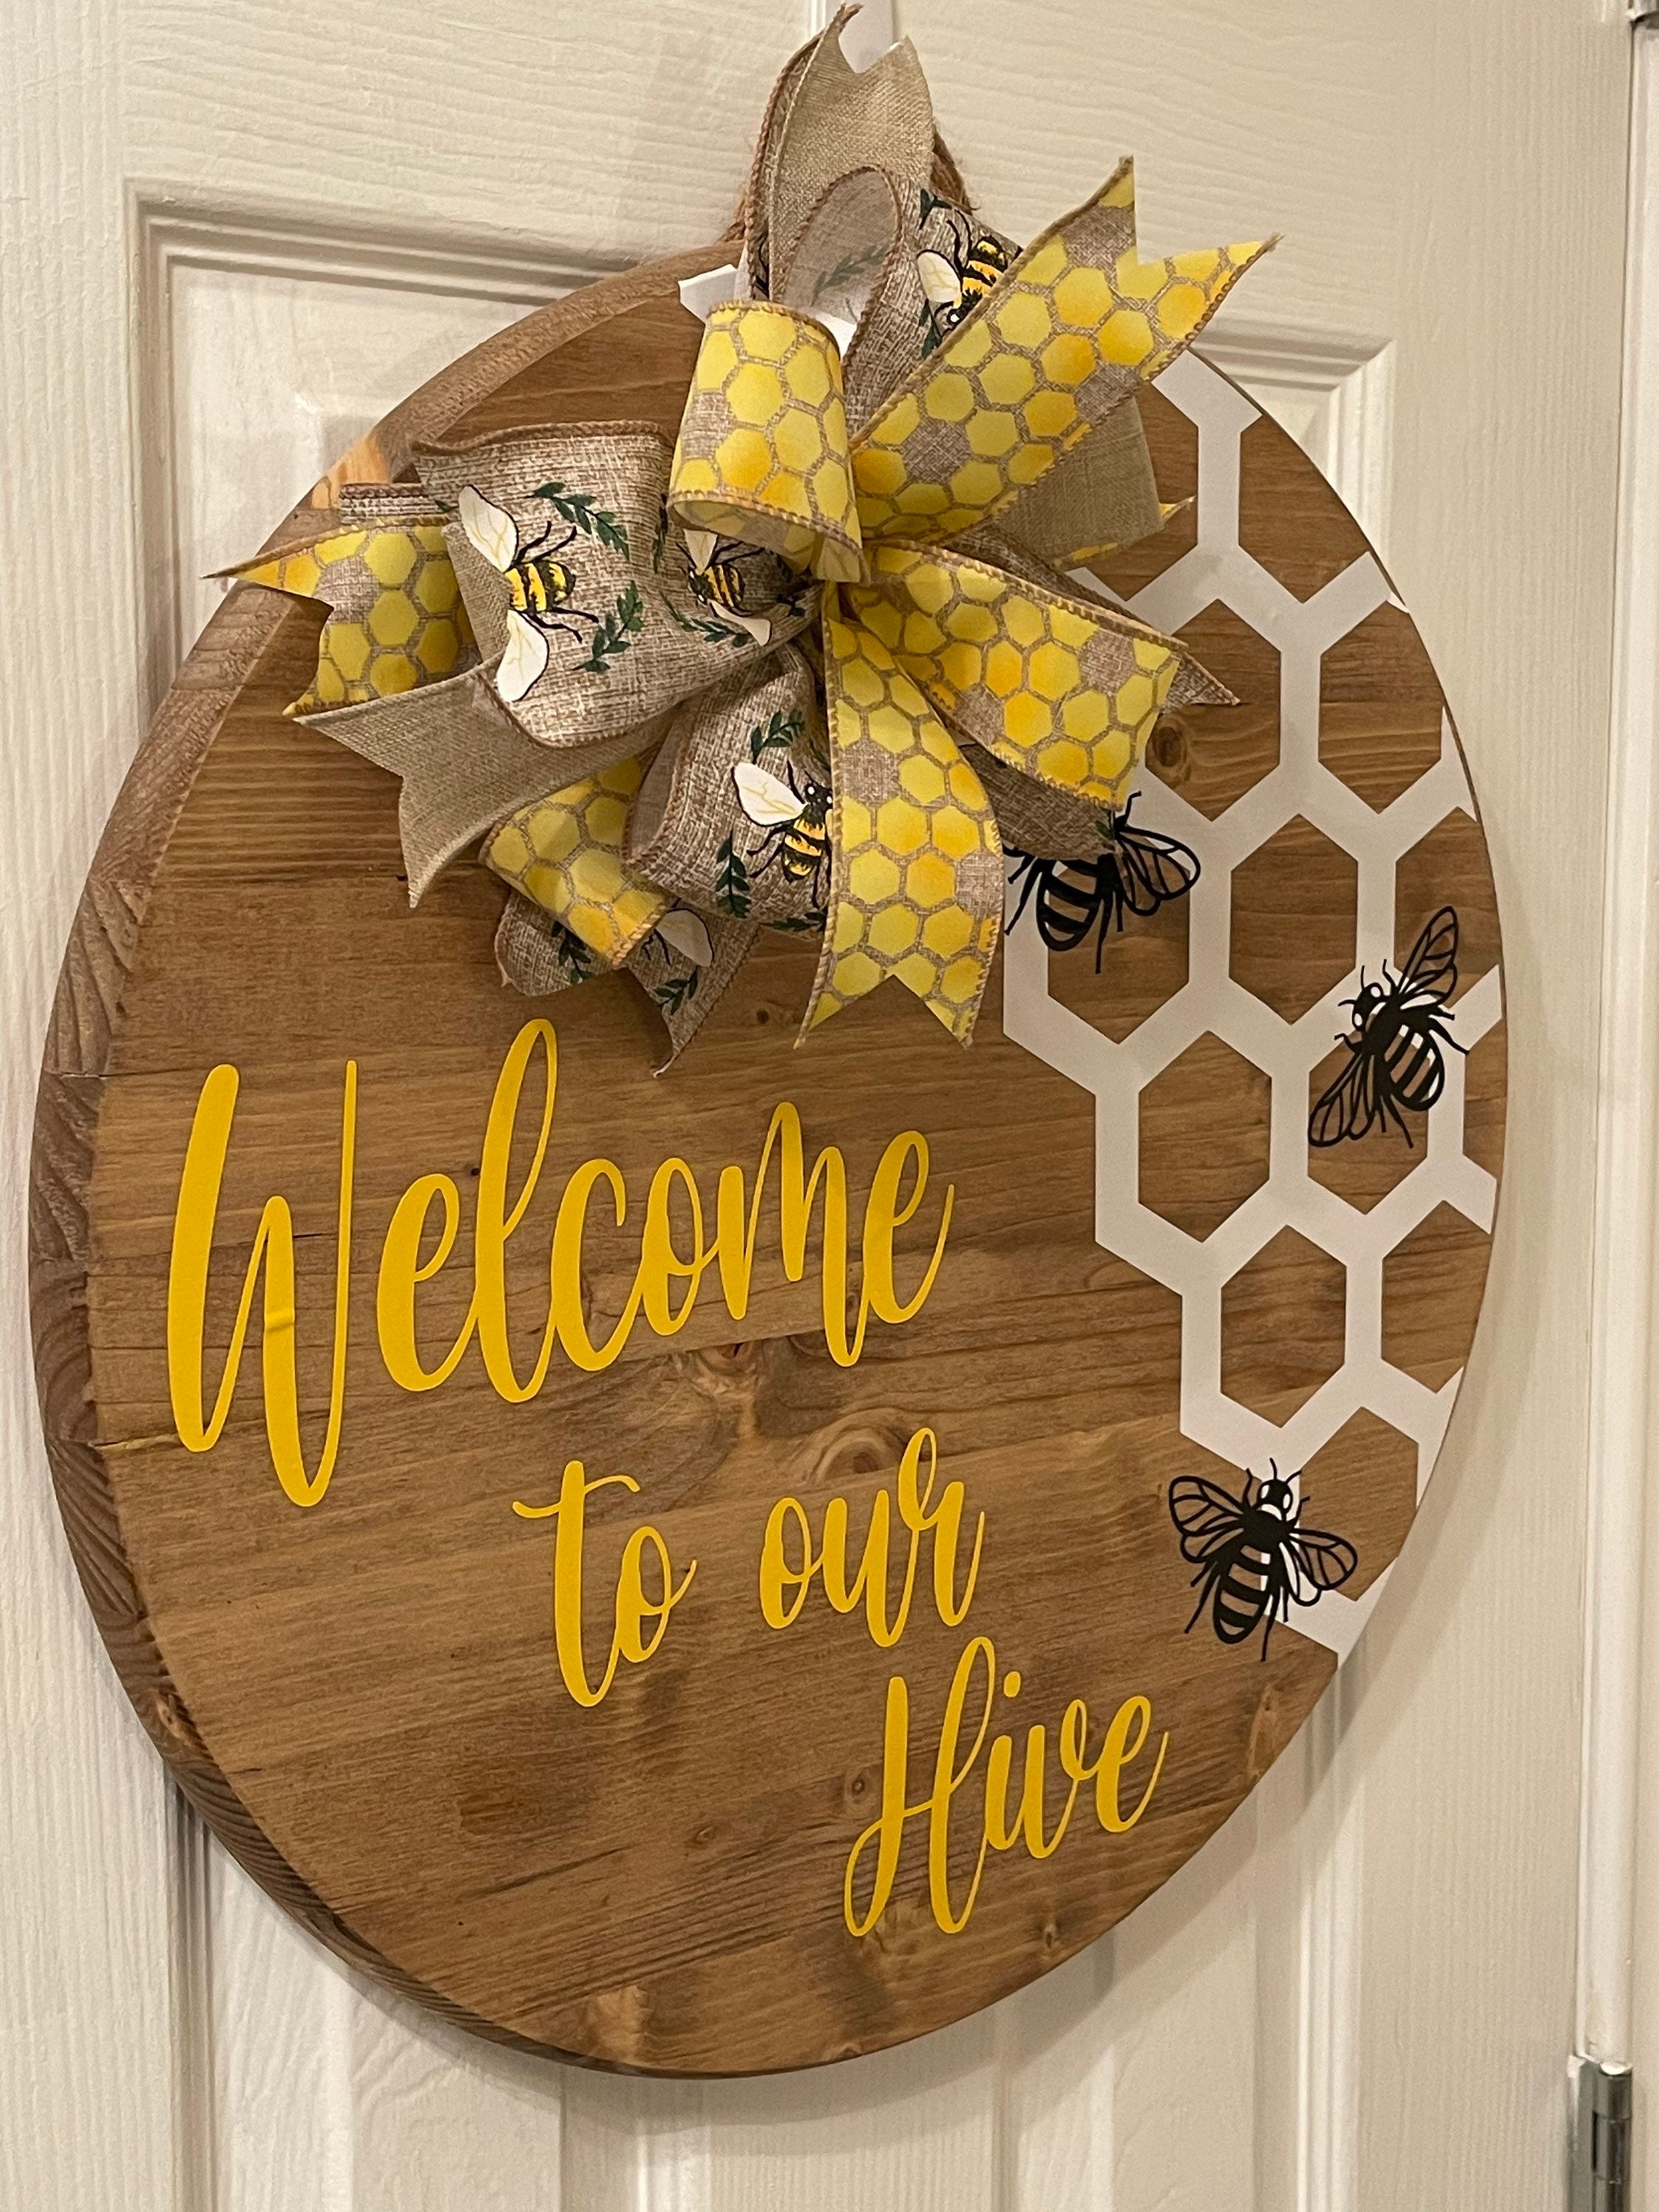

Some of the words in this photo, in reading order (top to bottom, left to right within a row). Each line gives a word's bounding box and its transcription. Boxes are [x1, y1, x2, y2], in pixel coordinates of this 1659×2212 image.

[167, 1020, 954, 1507] Welcome
[512, 1460, 697, 1706] to
[760, 1428, 985, 1647] our
[844, 1638, 1169, 1936] Hive
